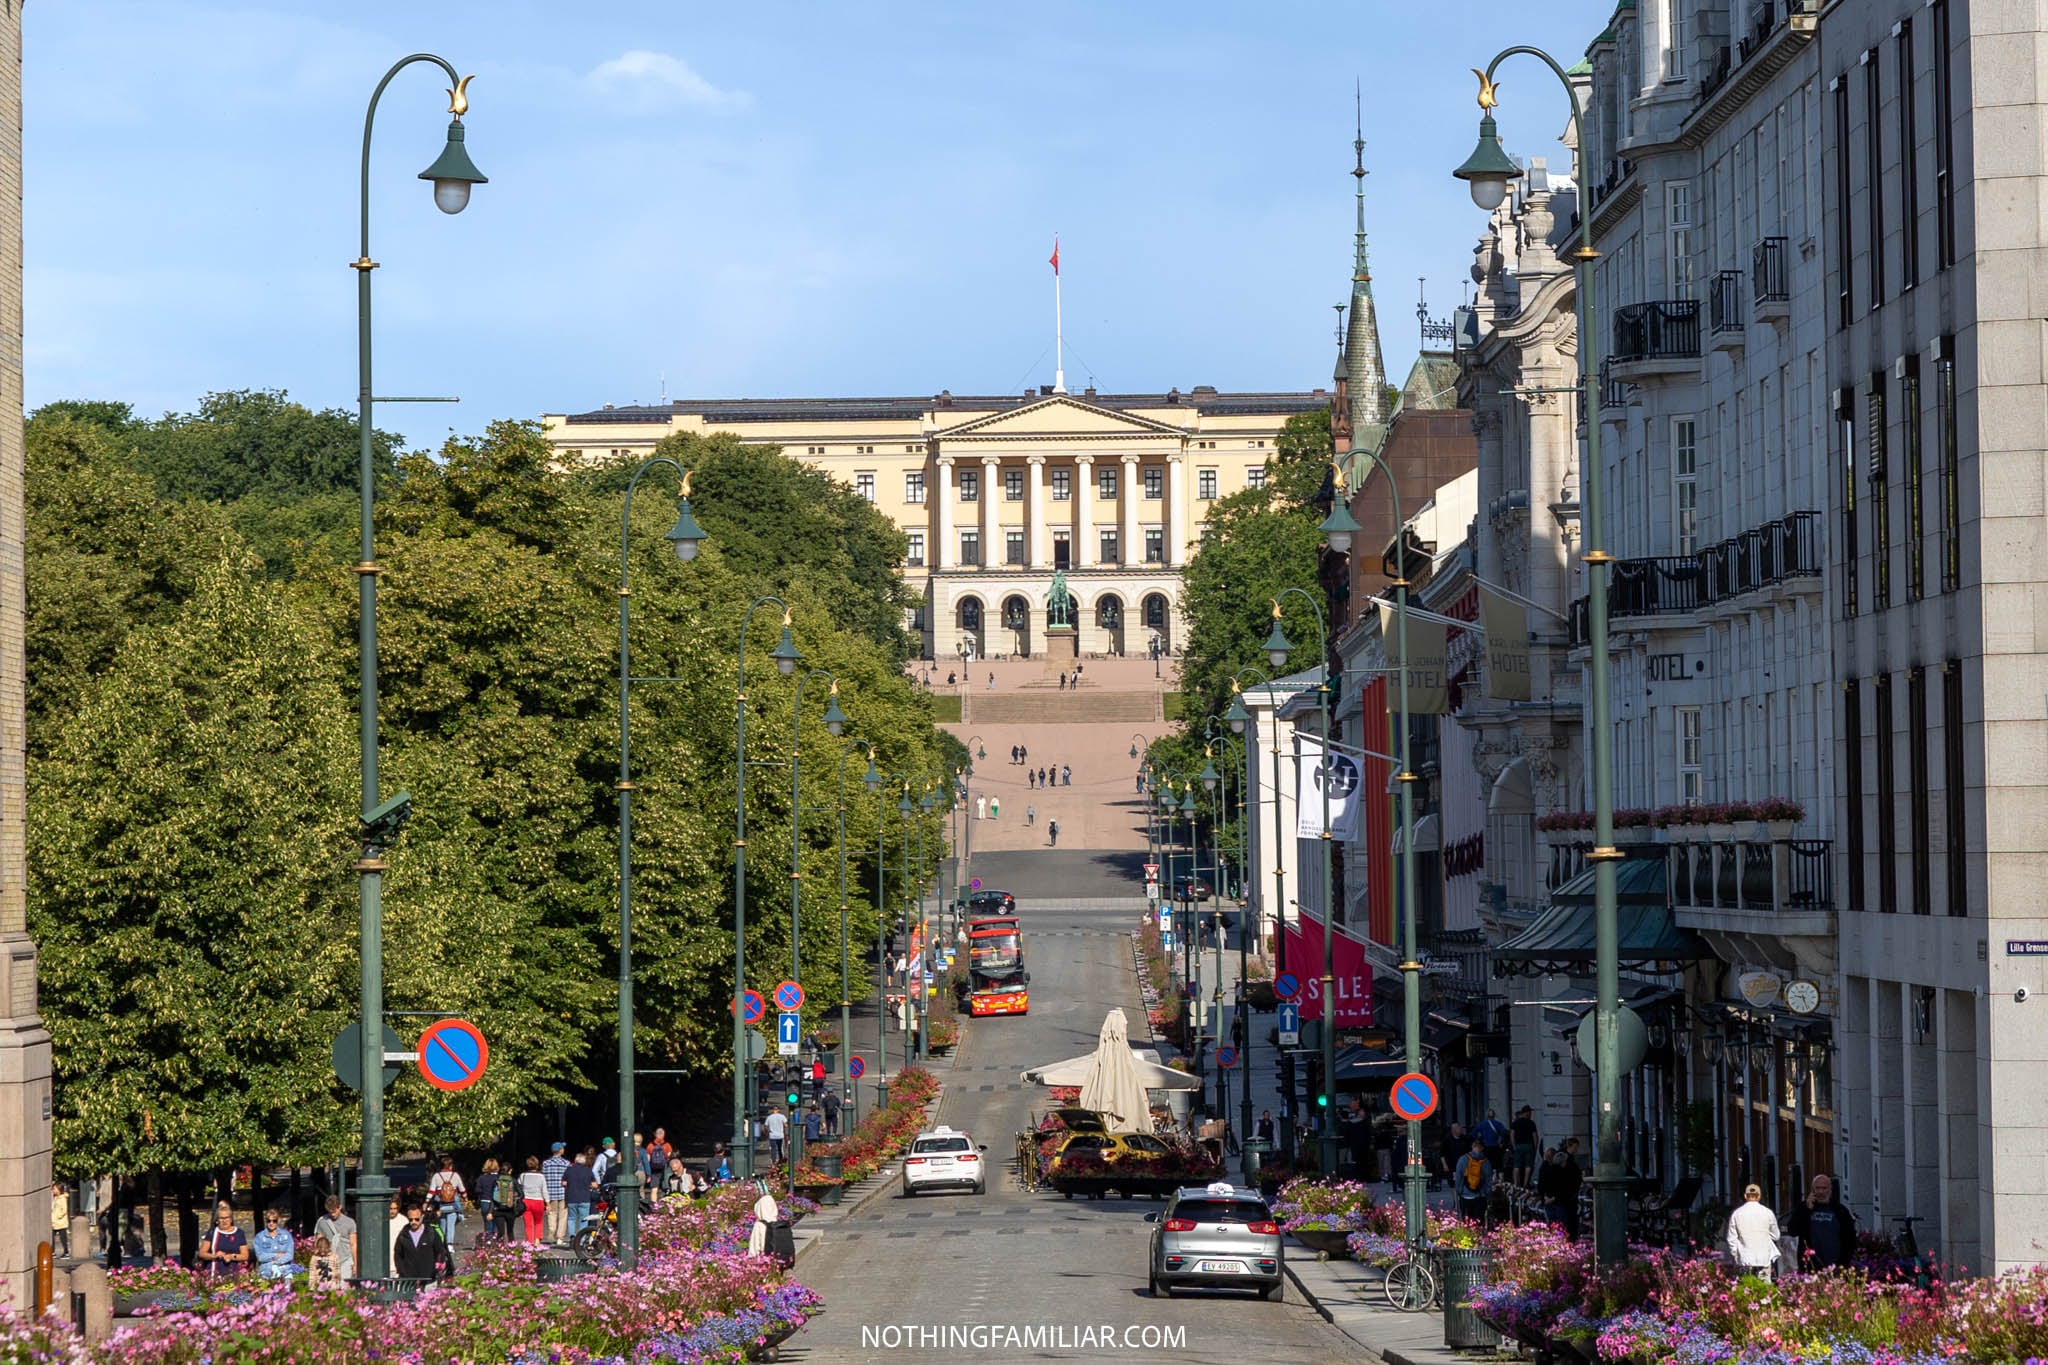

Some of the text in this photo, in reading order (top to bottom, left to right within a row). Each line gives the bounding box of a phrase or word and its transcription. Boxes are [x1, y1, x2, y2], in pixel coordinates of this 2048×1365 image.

[1648, 653, 1693, 681] HOTEL
[2010, 943, 2024, 952] Lille
[1308, 976, 1362, 999] SLE
